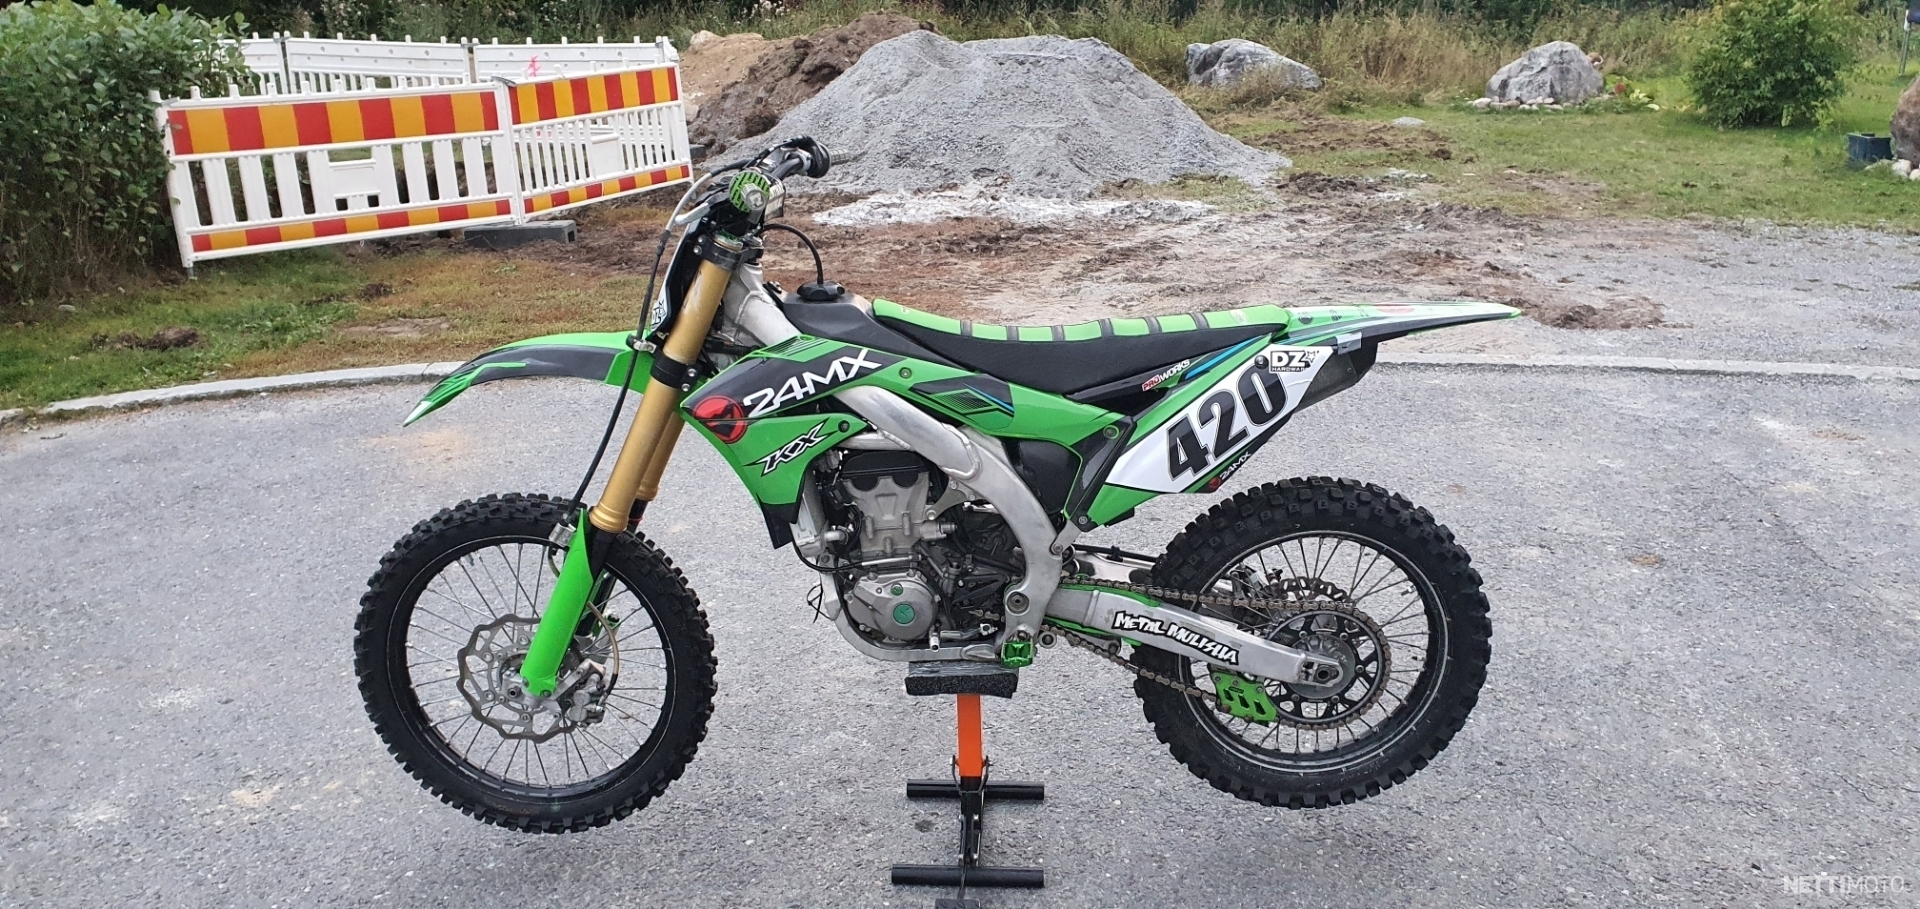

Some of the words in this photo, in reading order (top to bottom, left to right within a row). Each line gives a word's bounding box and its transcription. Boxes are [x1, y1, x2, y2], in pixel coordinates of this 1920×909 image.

[743, 349, 882, 418] 24MX
[1270, 351, 1306, 367] DZ
[758, 421, 832, 476] KX
[1168, 365, 1288, 481] 420
[1220, 451, 1251, 480] 24MX
